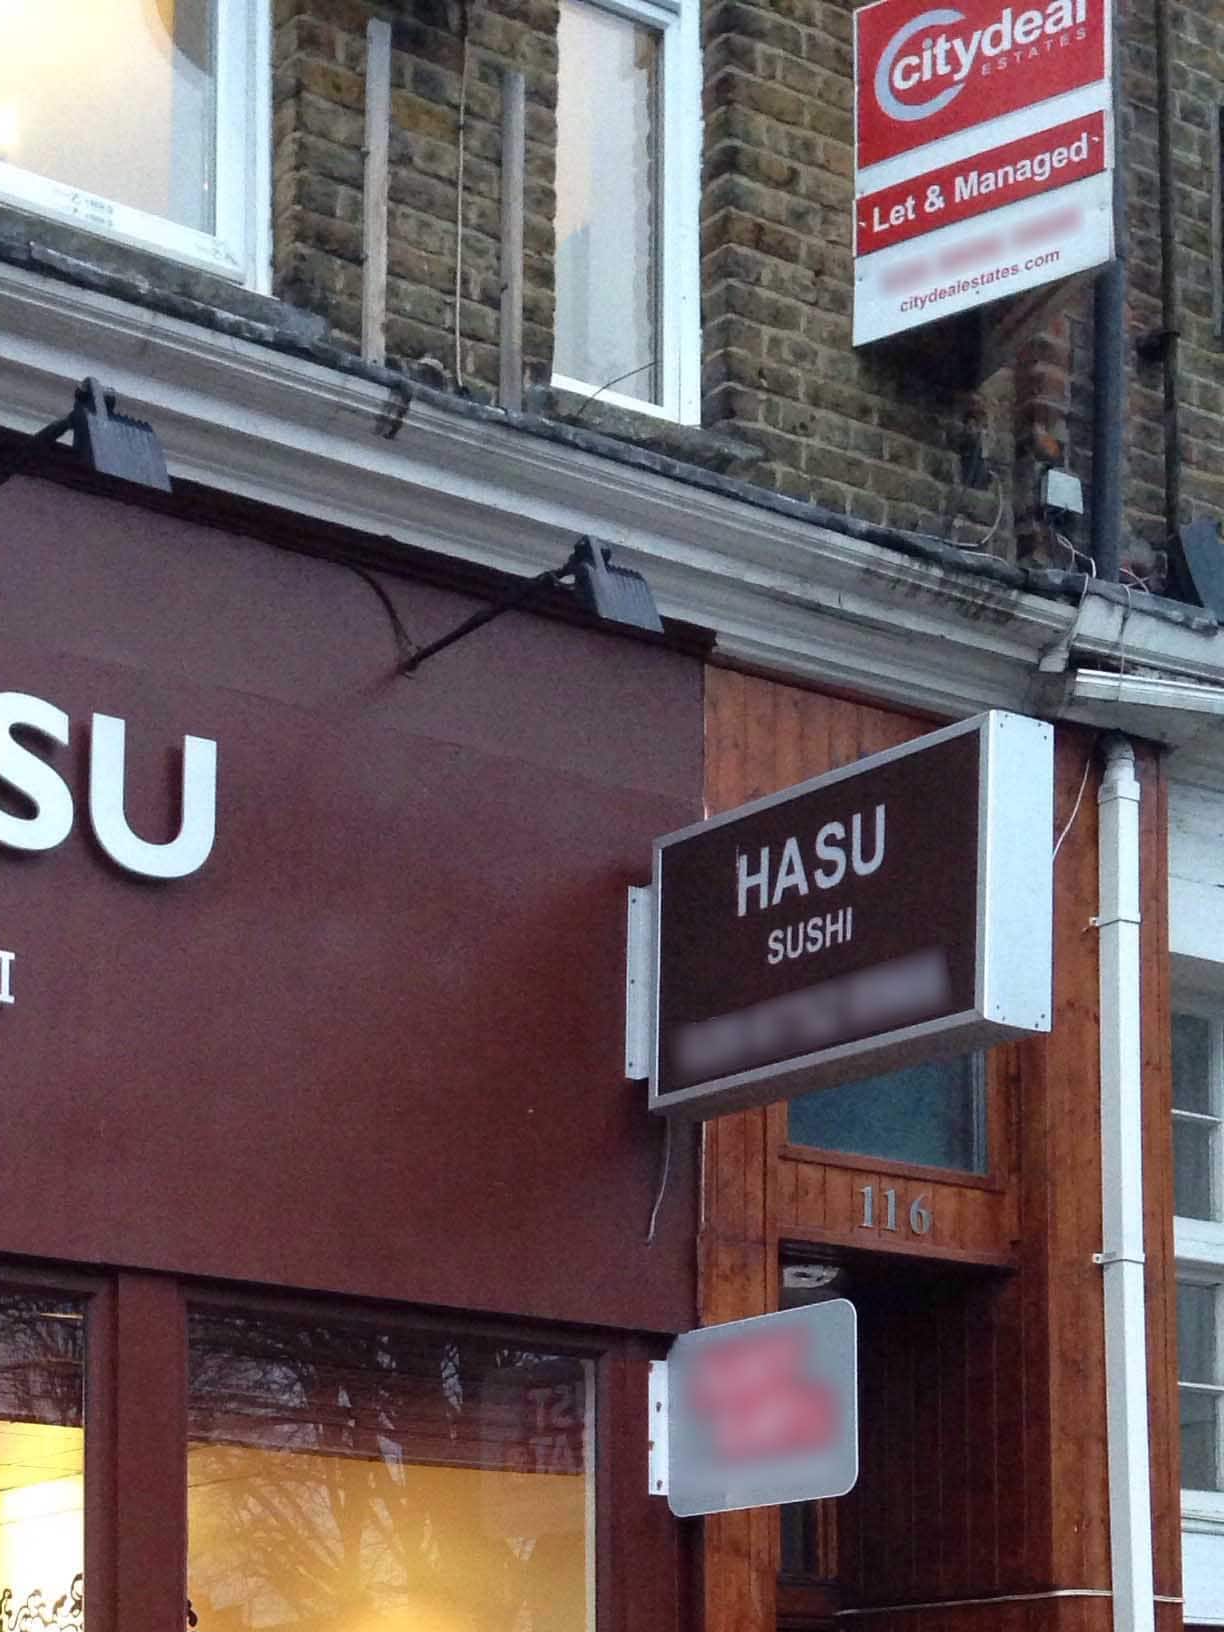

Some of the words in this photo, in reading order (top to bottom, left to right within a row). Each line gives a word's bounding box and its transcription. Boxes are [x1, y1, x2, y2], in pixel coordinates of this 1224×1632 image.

[981, 27, 1086, 76] ESTATES
[872, 195, 916, 233] Let
[923, 184, 946, 213] &
[954, 132, 1088, 203] Managed
[900, 250, 1060, 313] citydealestatescom
[737, 803, 886, 917] HASU
[767, 906, 853, 965] SUSHI
[858, 1186, 934, 1233] 116
